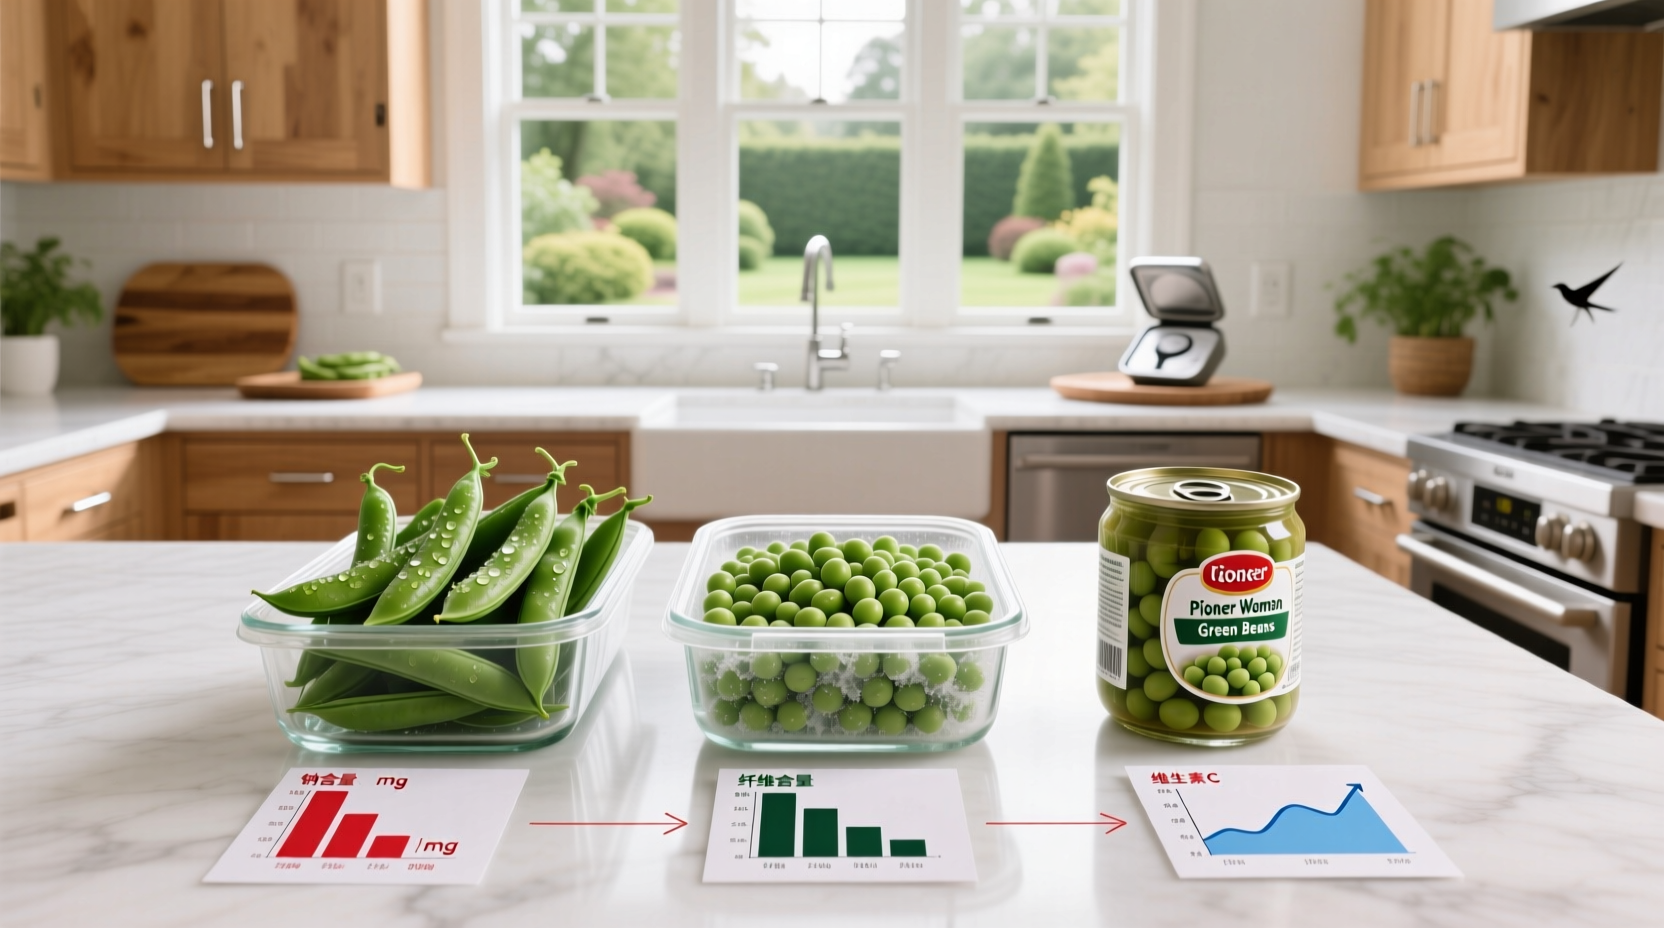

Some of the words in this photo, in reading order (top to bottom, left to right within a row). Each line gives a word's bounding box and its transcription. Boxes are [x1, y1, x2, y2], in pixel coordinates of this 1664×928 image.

[1190, 600, 1236, 616] Pioner
[1240, 598, 1282, 612] Woman
[1198, 623, 1238, 637] Green
[1242, 621, 1275, 634] Beans
[376, 776, 408, 789] mg
